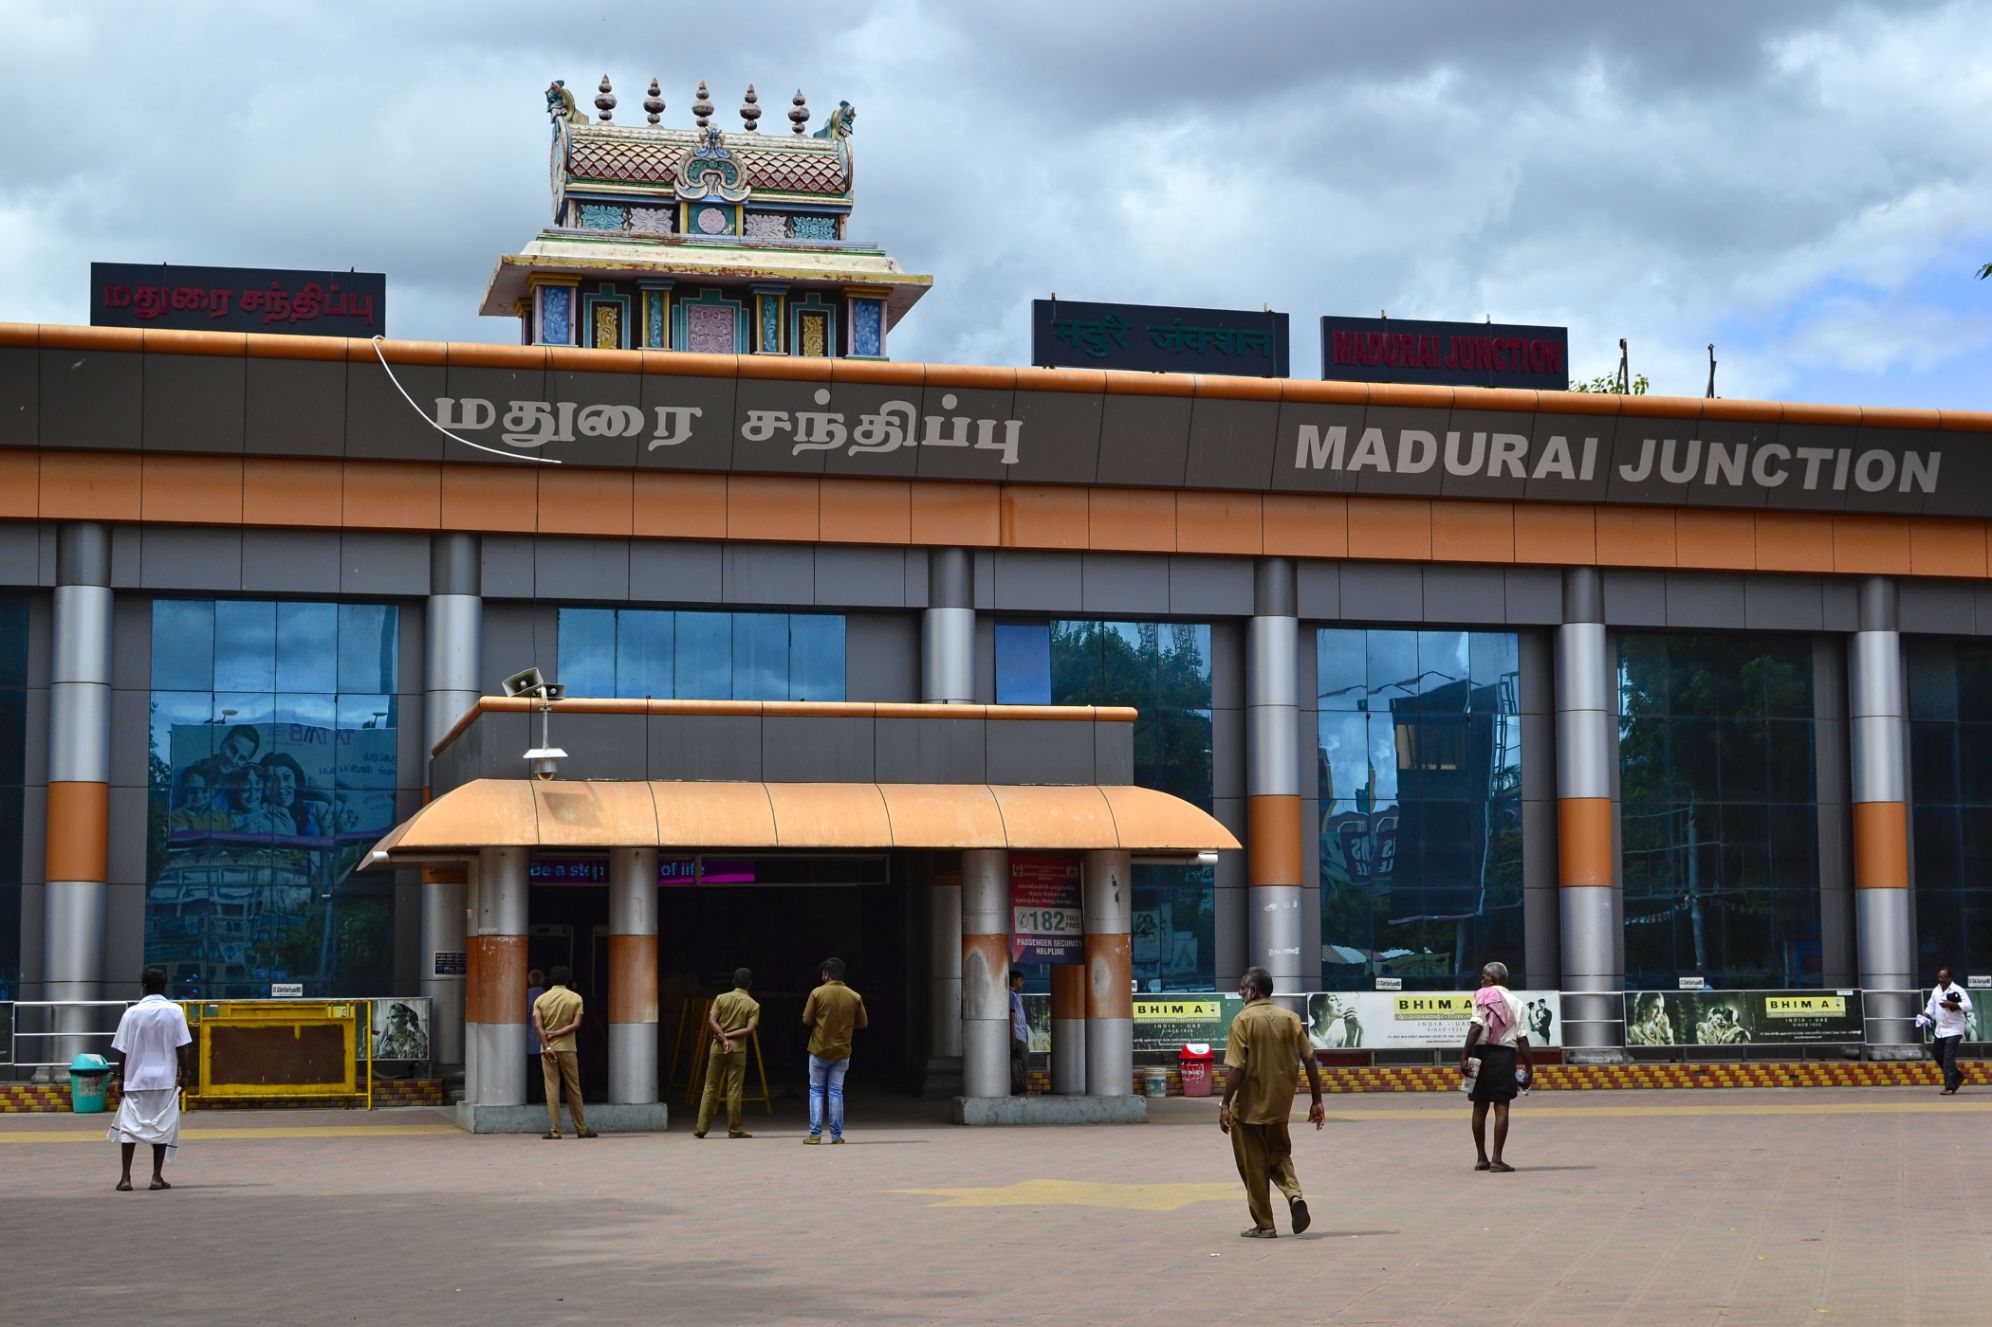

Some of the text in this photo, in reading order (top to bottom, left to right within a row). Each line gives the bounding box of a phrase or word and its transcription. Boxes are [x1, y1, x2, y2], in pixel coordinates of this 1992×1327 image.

[104, 280, 375, 325] மதுரை சந்திப்பு
[1331, 330, 1563, 375] MADURAI JUNCTION
[435, 388, 1024, 464] மதுரை சந்திப்பு
[1294, 423, 1943, 494] MADURAI JUNCTION
[660, 862, 677, 876] of
[1028, 910, 1065, 931] 182
[1065, 921, 1080, 929] FREE
[1016, 938, 1082, 948] PASSENGER SECURITY
[1036, 947, 1065, 956] HELPLINE
